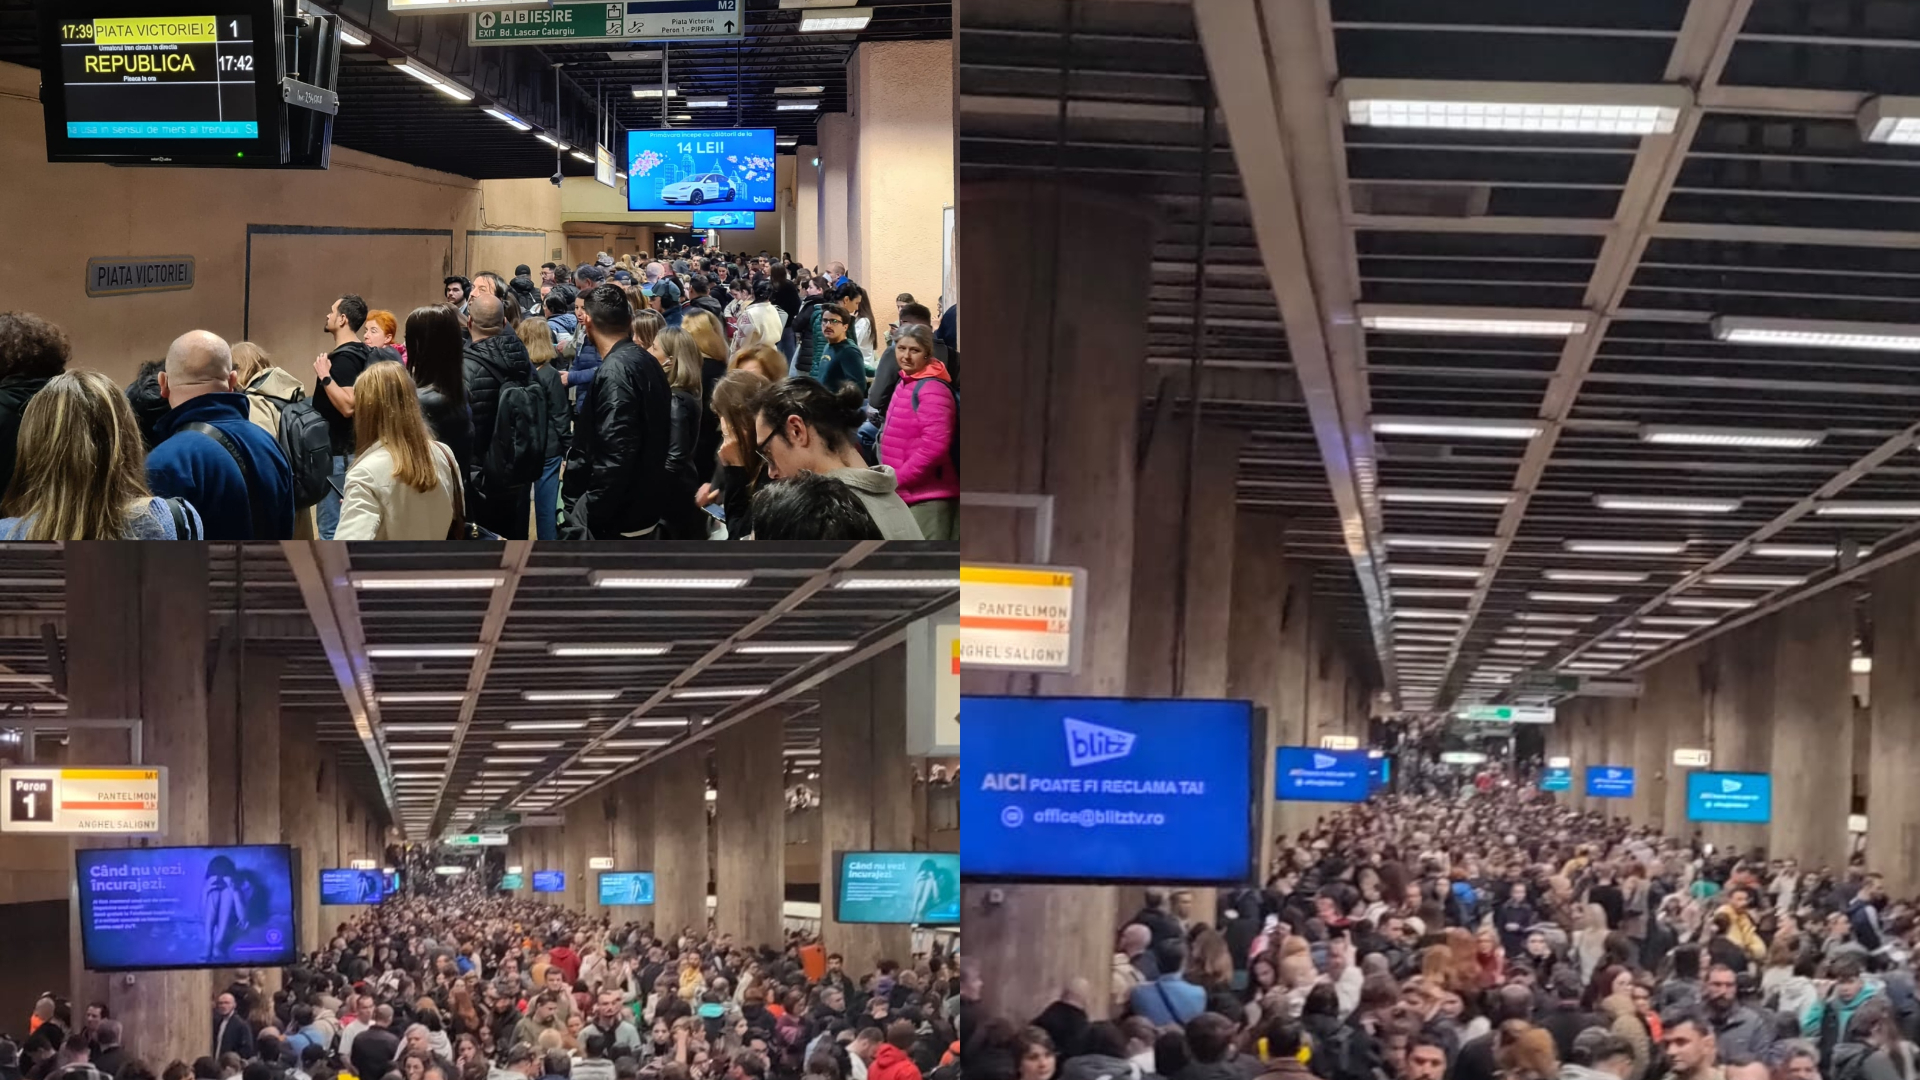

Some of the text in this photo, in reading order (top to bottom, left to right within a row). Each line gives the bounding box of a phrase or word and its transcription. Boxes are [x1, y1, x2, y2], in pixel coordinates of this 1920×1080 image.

[718, 1, 734, 10] M2
[504, 14, 511, 22] A
[519, 14, 526, 22] B
[62, 22, 214, 38] 17:39 PIATA VICTORIEI 2
[230, 20, 238, 38] 1
[500, 28, 512, 36] Bd.
[542, 27, 574, 36] Catargiu
[85, 54, 195, 72] REPUBLICA
[219, 55, 254, 70] 17:42
[147, 126, 158, 134] de
[676, 142, 724, 154] 14 LEI!
[98, 264, 188, 286] PIATA VICTORIEI
[978, 602, 1068, 618] PANTELIMON
[1004, 646, 1065, 662] SALIGNY
[1072, 730, 1128, 758] blitz
[16, 780, 46, 791] Peron
[981, 772, 1204, 794] AICI POATE FI RECLAMA TA!
[98, 792, 156, 800] PANTELIMON
[22, 793, 35, 819] 1
[78, 820, 156, 828] ANGHEL SALIGNY
[1033, 808, 1166, 827] office@blitztv.ro
[90, 864, 128, 877] Când
[131, 866, 150, 876] nu
